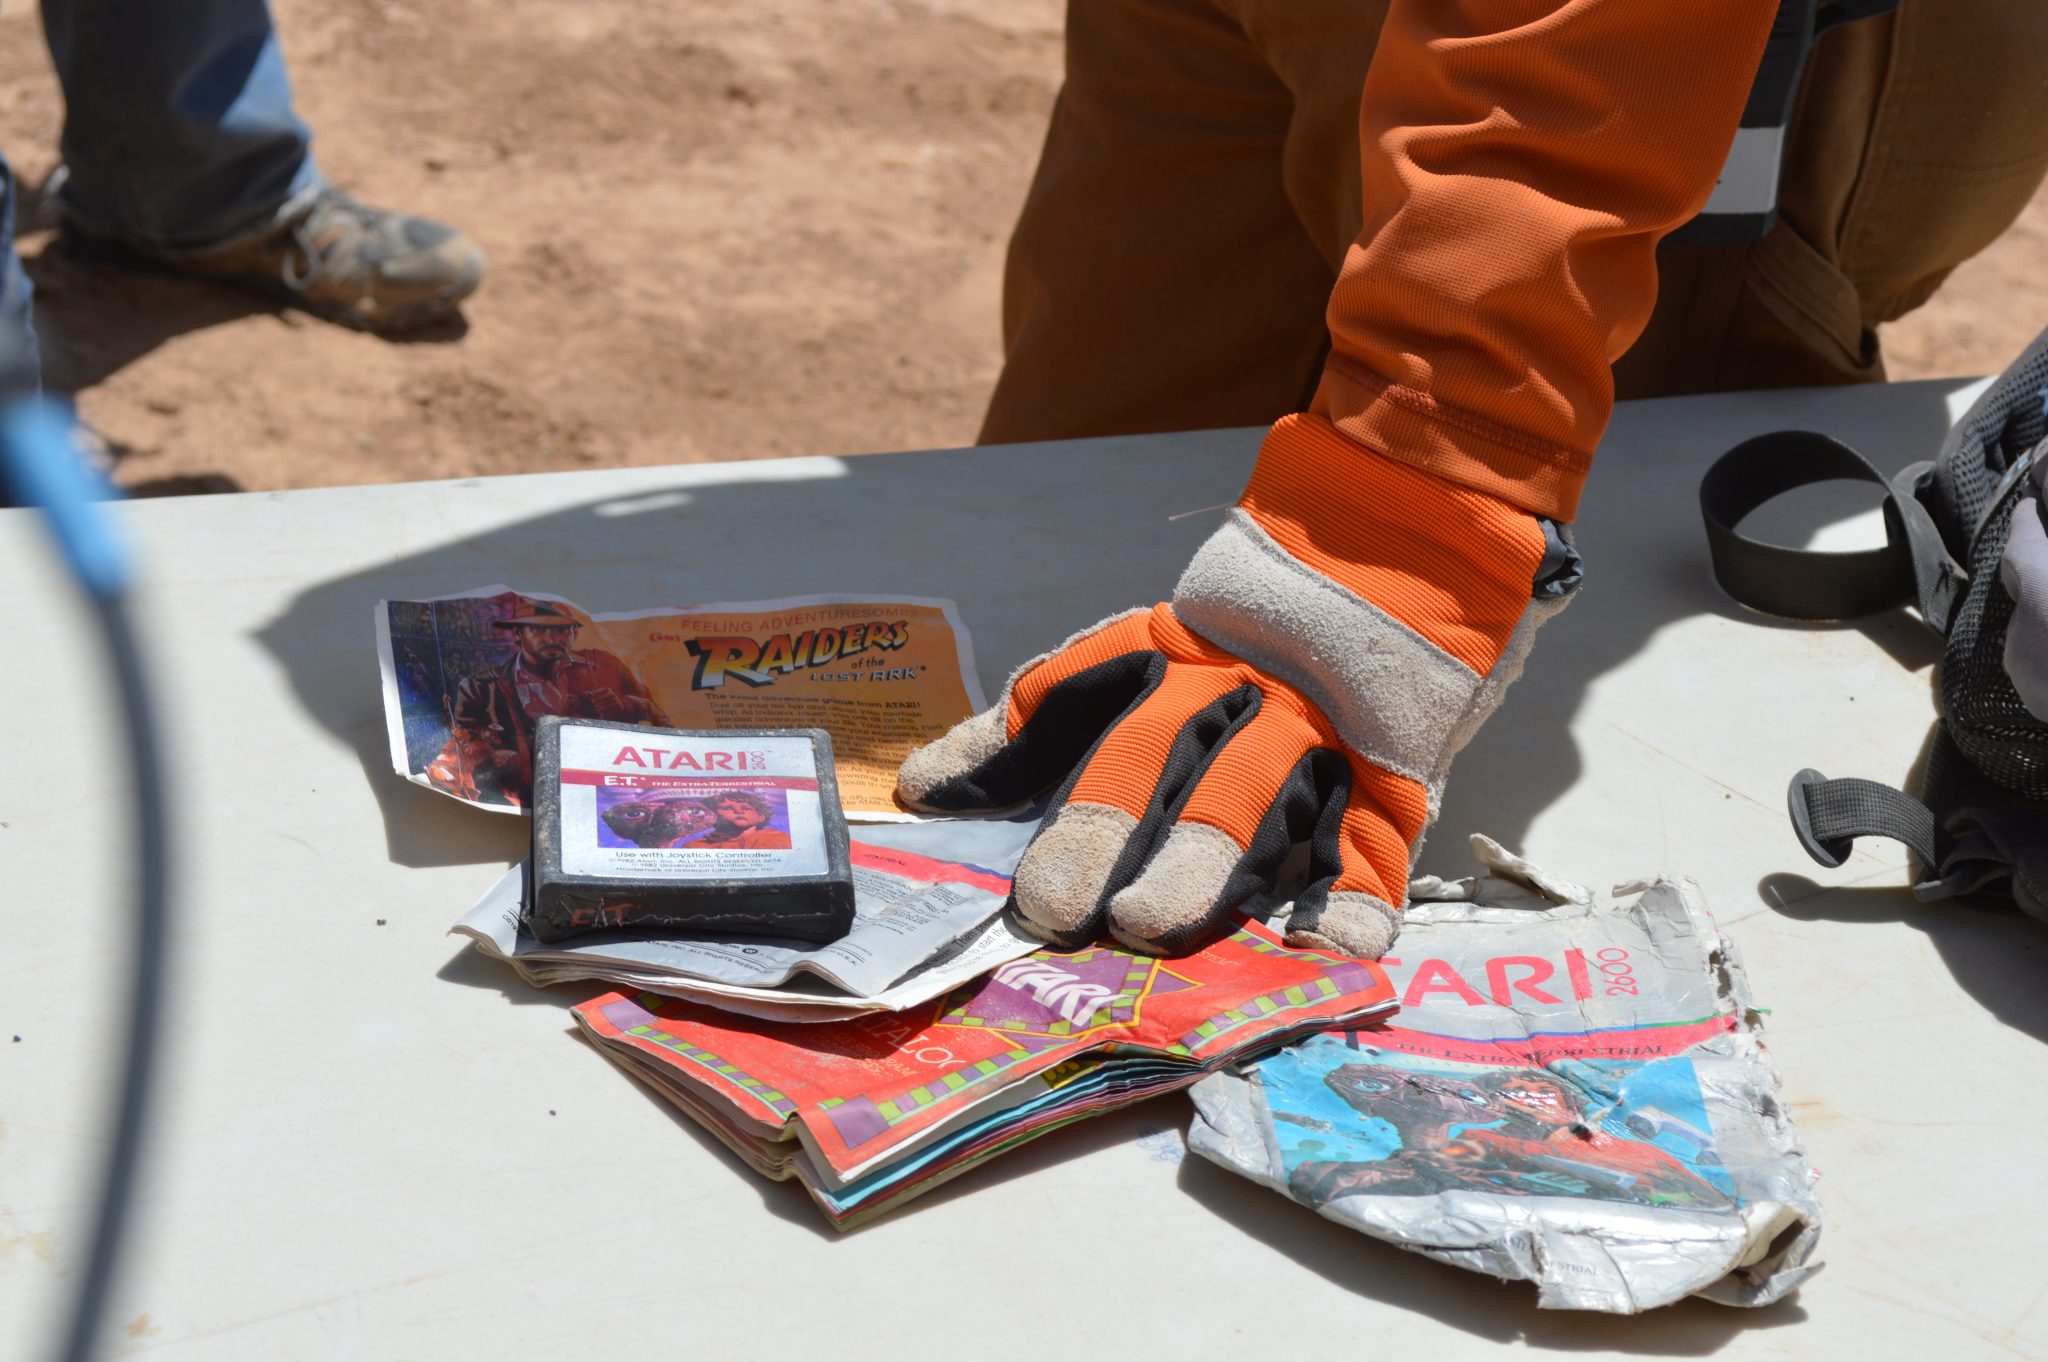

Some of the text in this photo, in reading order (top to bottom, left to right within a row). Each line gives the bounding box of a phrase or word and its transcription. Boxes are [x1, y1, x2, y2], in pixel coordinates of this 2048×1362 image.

[681, 618, 753, 633] FEELING
[683, 619, 909, 690] RAIDERS
[851, 656, 885, 669] of the
[613, 746, 747, 771] ATARI
[651, 780, 670, 788] THE
[640, 851, 664, 859] with
[667, 851, 711, 860] Joystick
[715, 851, 773, 860] Controller
[1596, 947, 1639, 998] 2600
